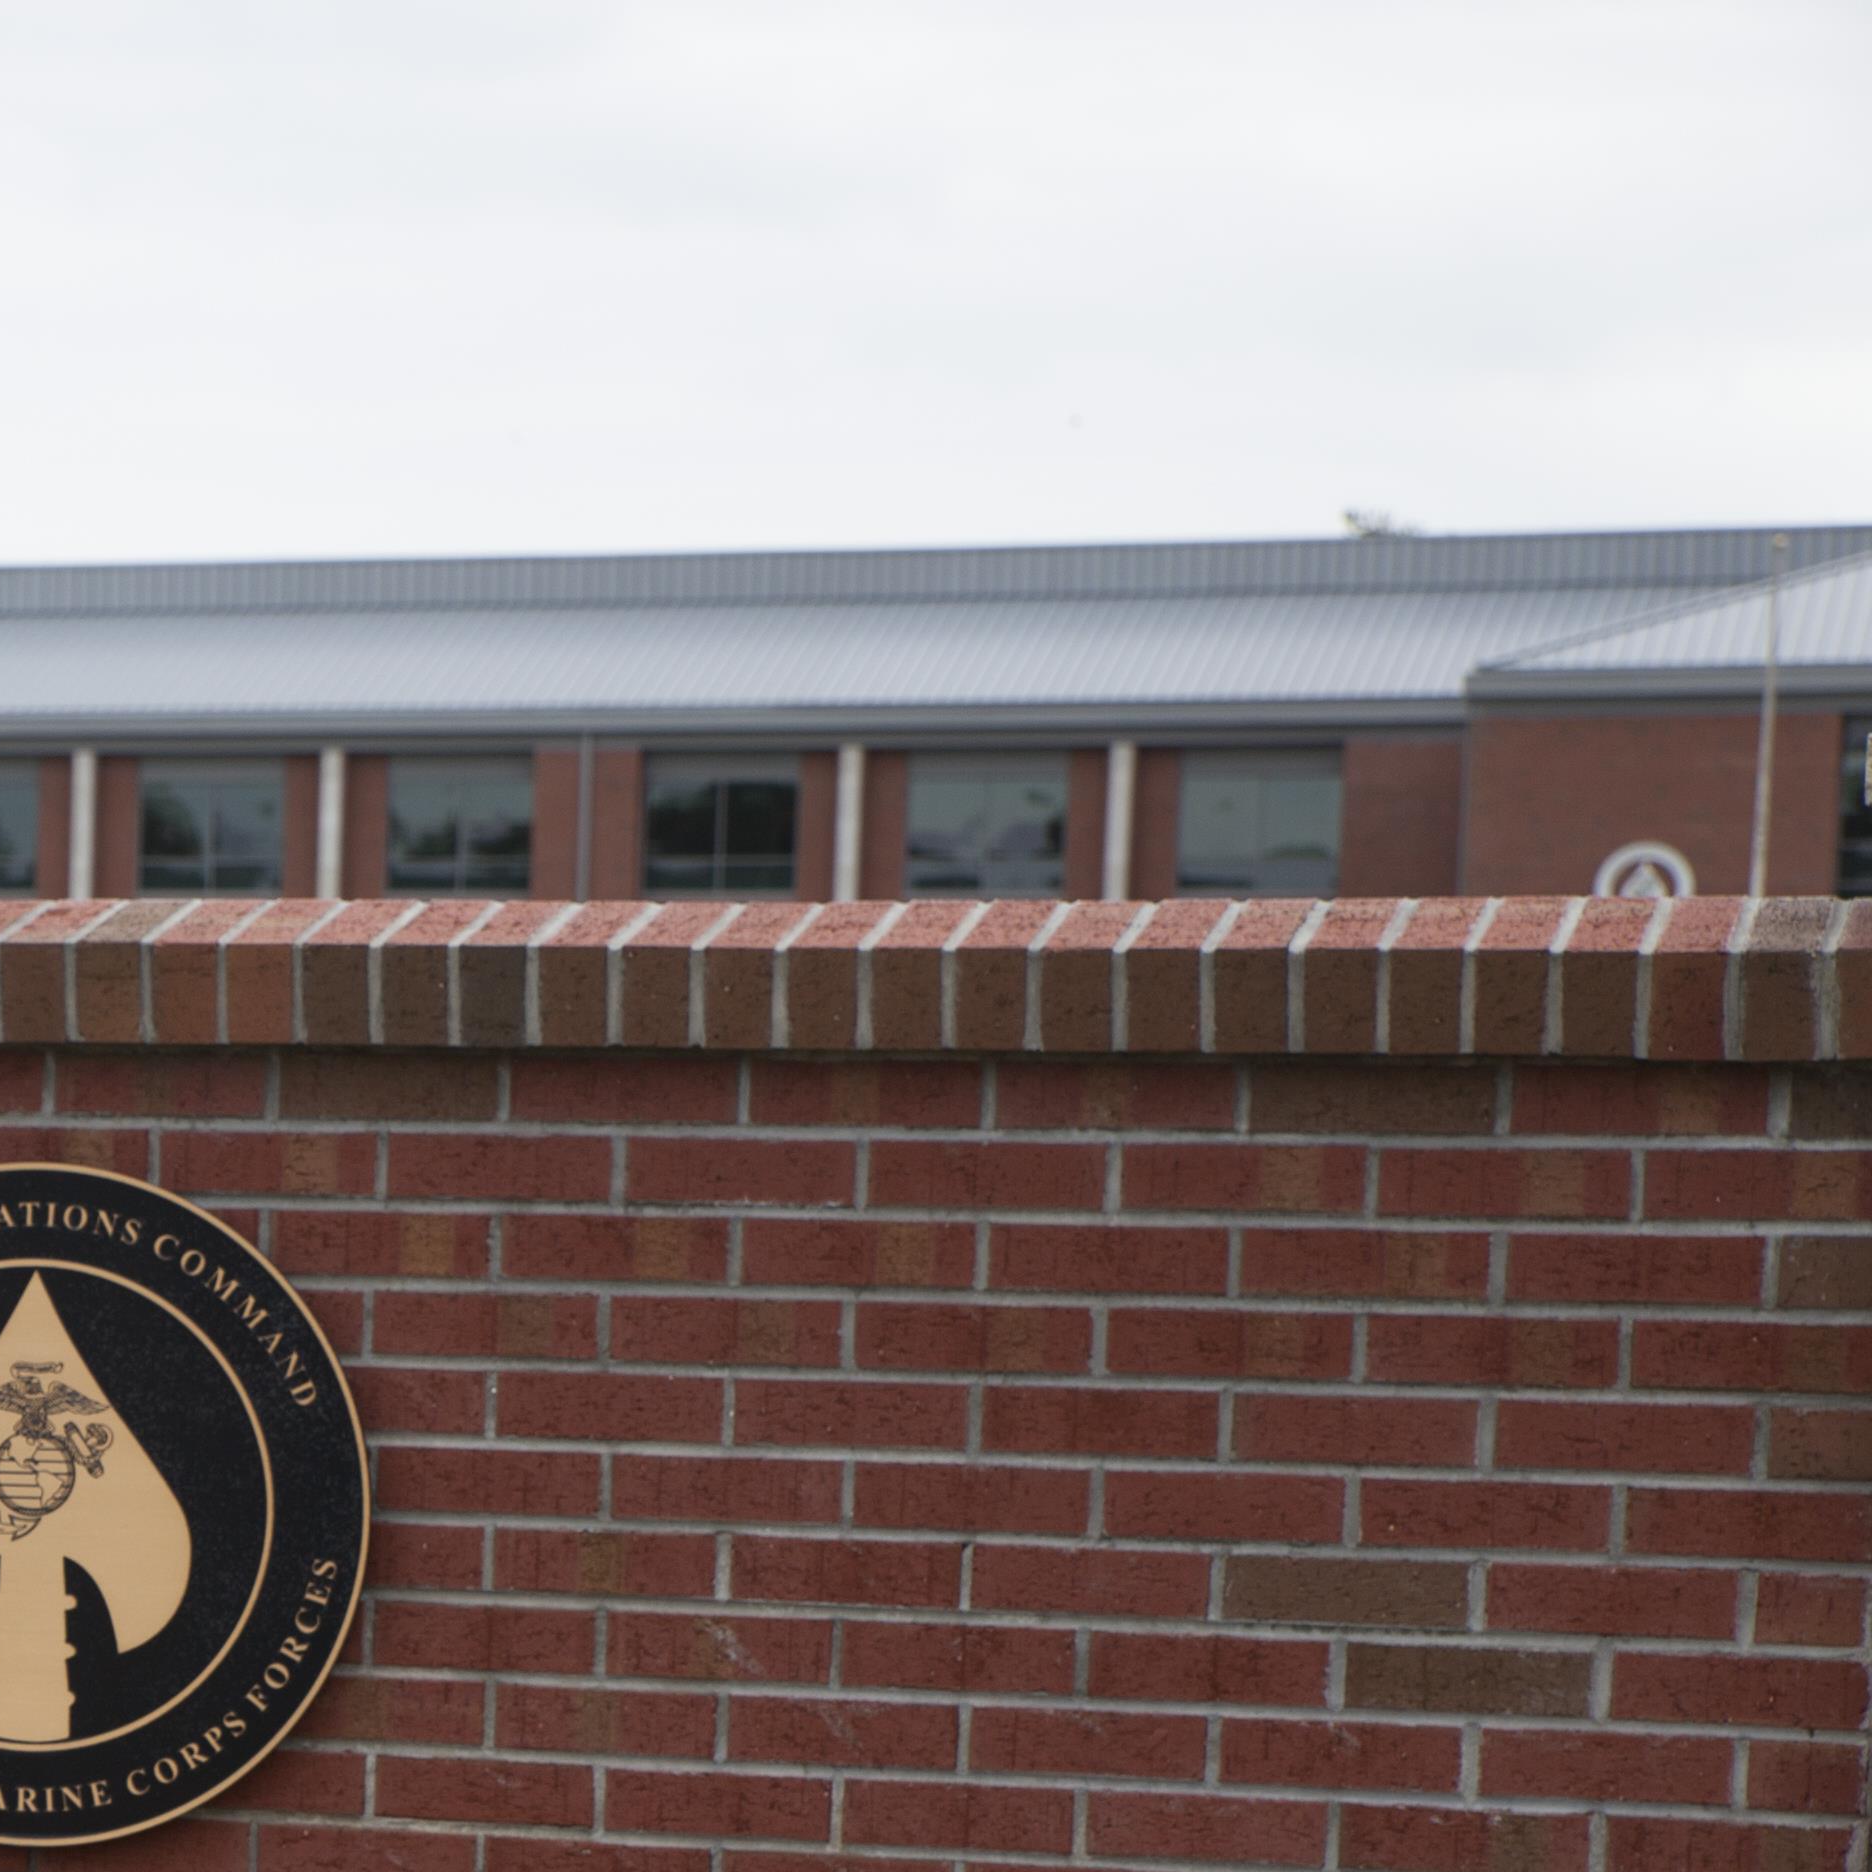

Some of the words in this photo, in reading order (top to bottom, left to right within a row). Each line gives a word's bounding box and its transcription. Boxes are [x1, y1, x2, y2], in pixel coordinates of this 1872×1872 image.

[152, 1233, 318, 1409] COMMAND
[125, 1711, 249, 1798] CORPS
[245, 1555, 339, 1711] FORCES
